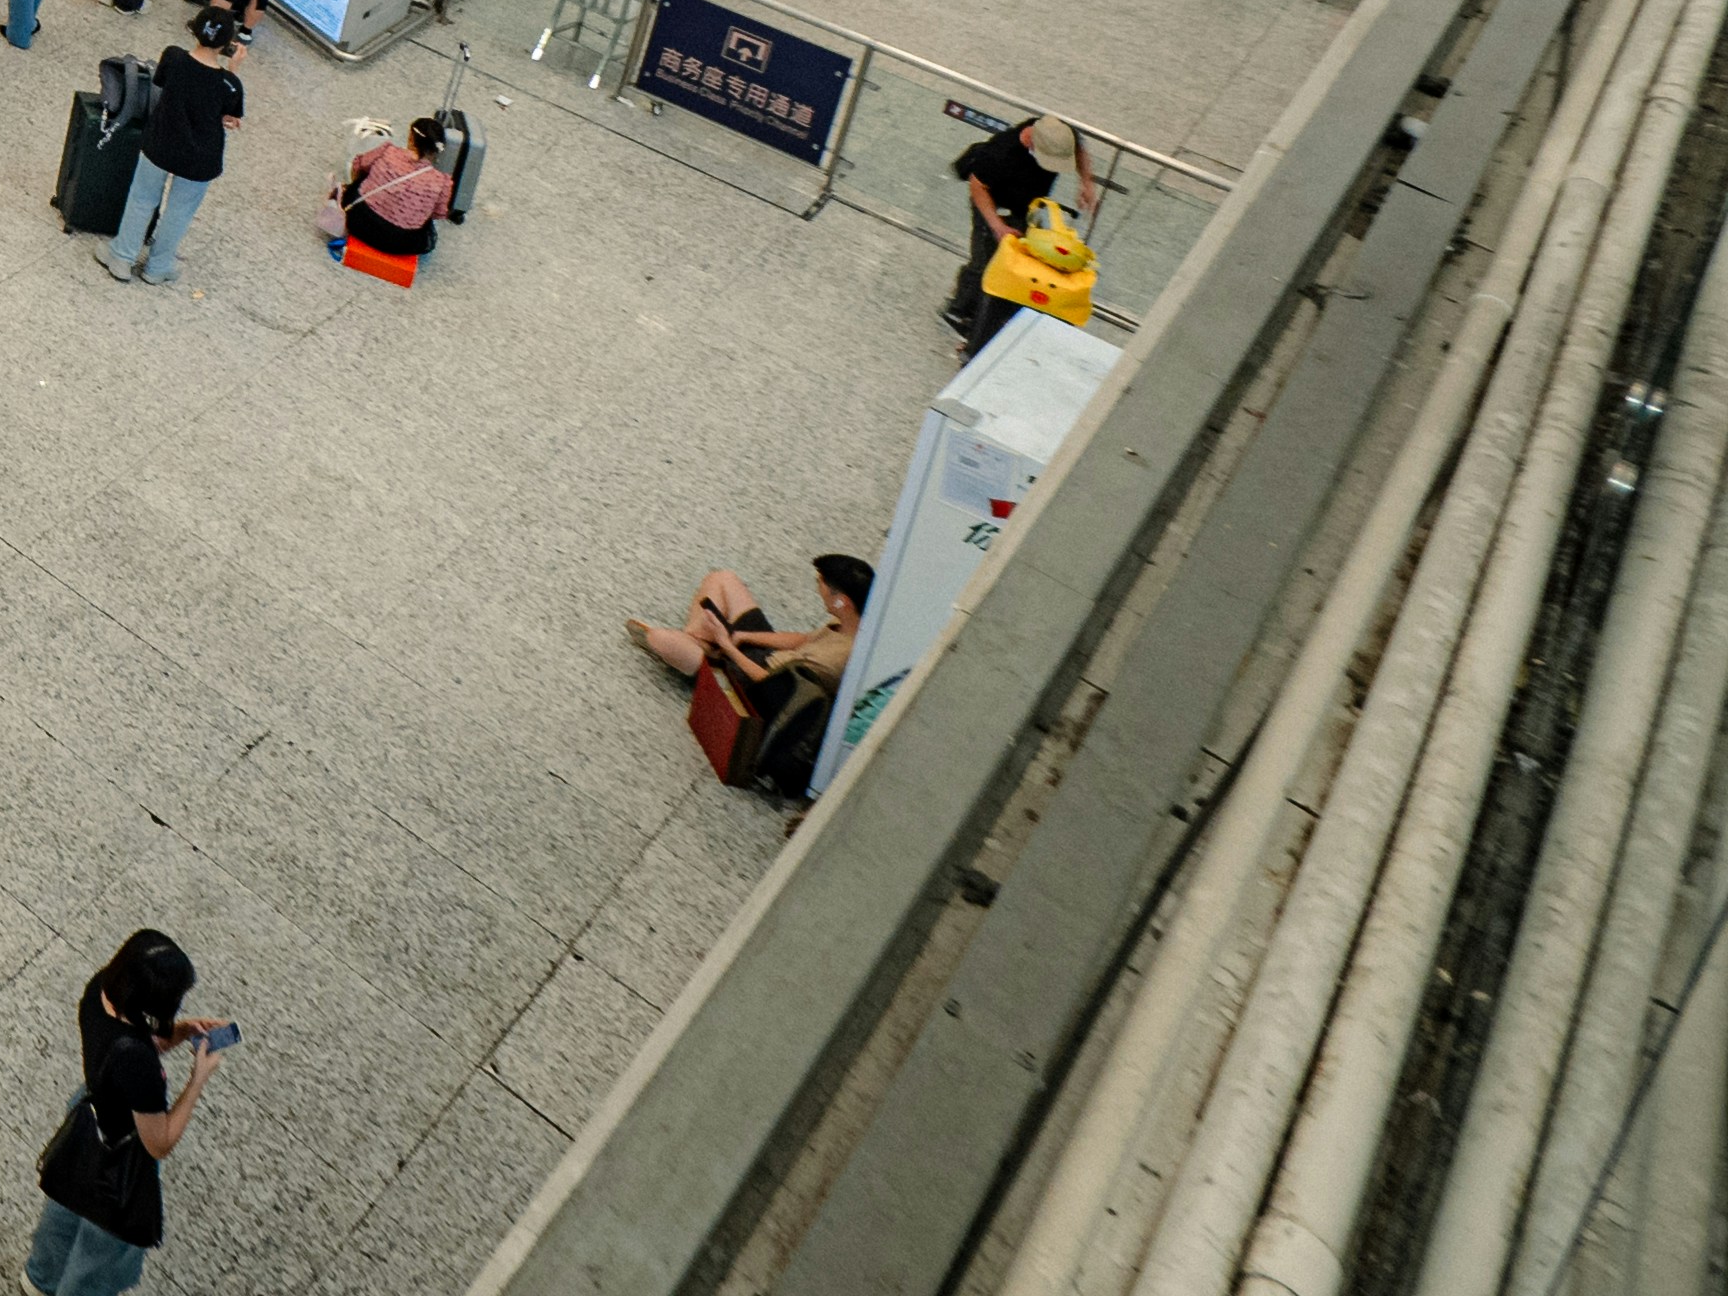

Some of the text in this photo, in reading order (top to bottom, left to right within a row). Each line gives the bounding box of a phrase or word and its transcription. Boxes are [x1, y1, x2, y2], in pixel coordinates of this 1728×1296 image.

[659, 47, 815, 128] 商务座专用通道
